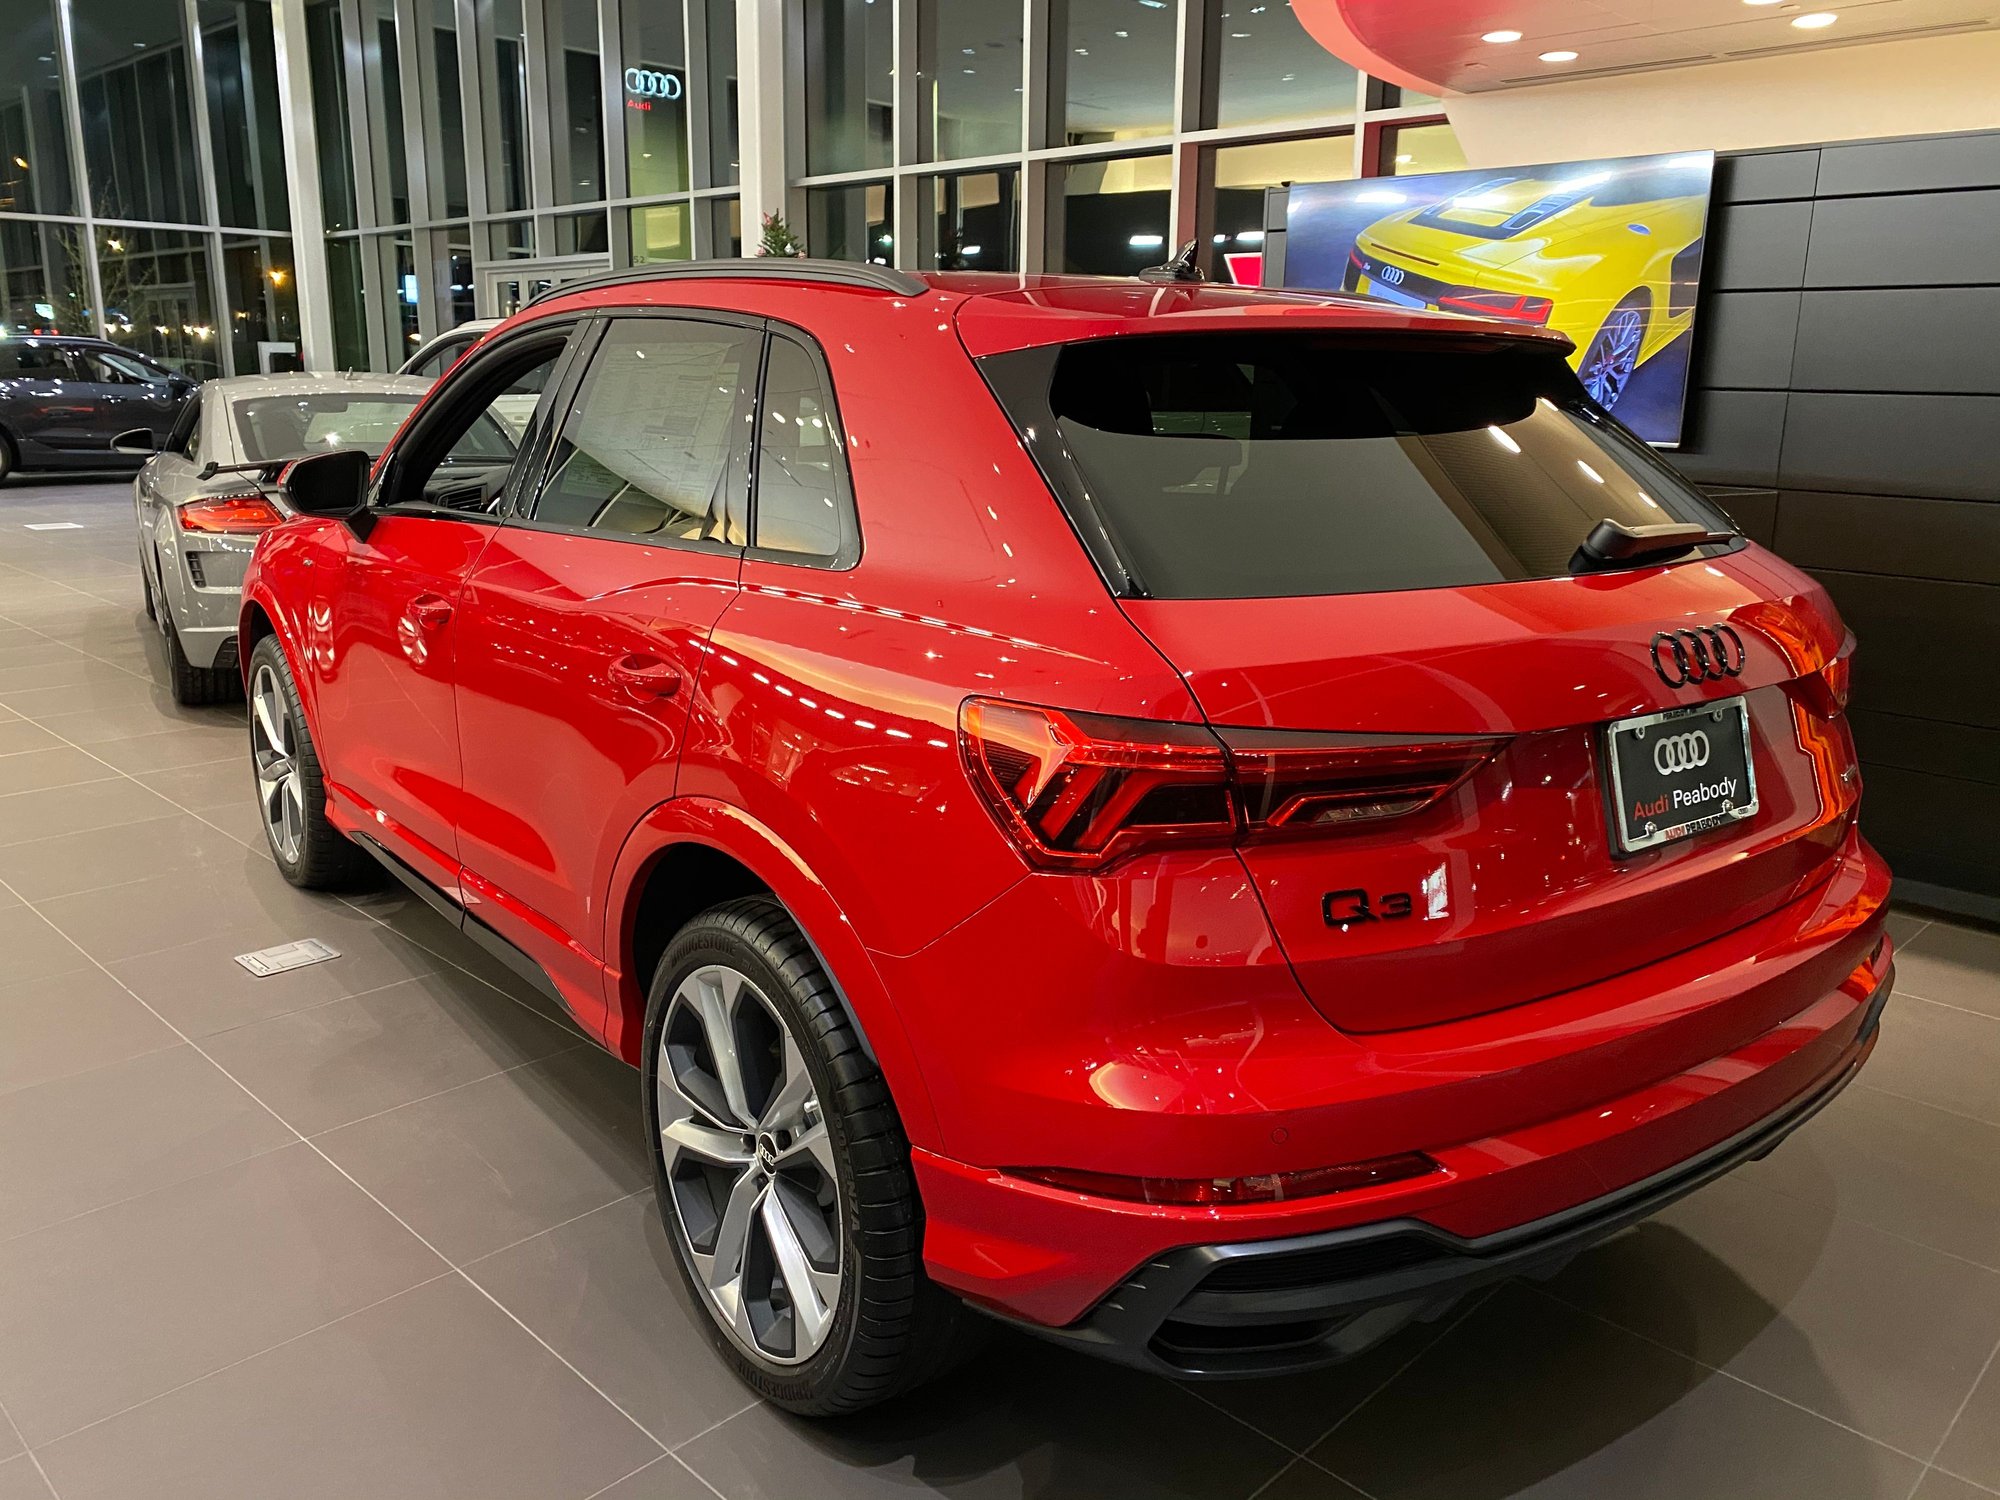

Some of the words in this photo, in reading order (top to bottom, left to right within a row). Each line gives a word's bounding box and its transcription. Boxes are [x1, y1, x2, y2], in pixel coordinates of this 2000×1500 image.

[626, 99, 652, 111] Audi
[1633, 794, 1669, 821] Audi
[1672, 776, 1737, 809] Peabody
[1685, 815, 1722, 835] PEABODY
[1321, 886, 1413, 928] Q3
[671, 933, 738, 968] BRIDGESTONE
[834, 1113, 861, 1231] POTENZA
